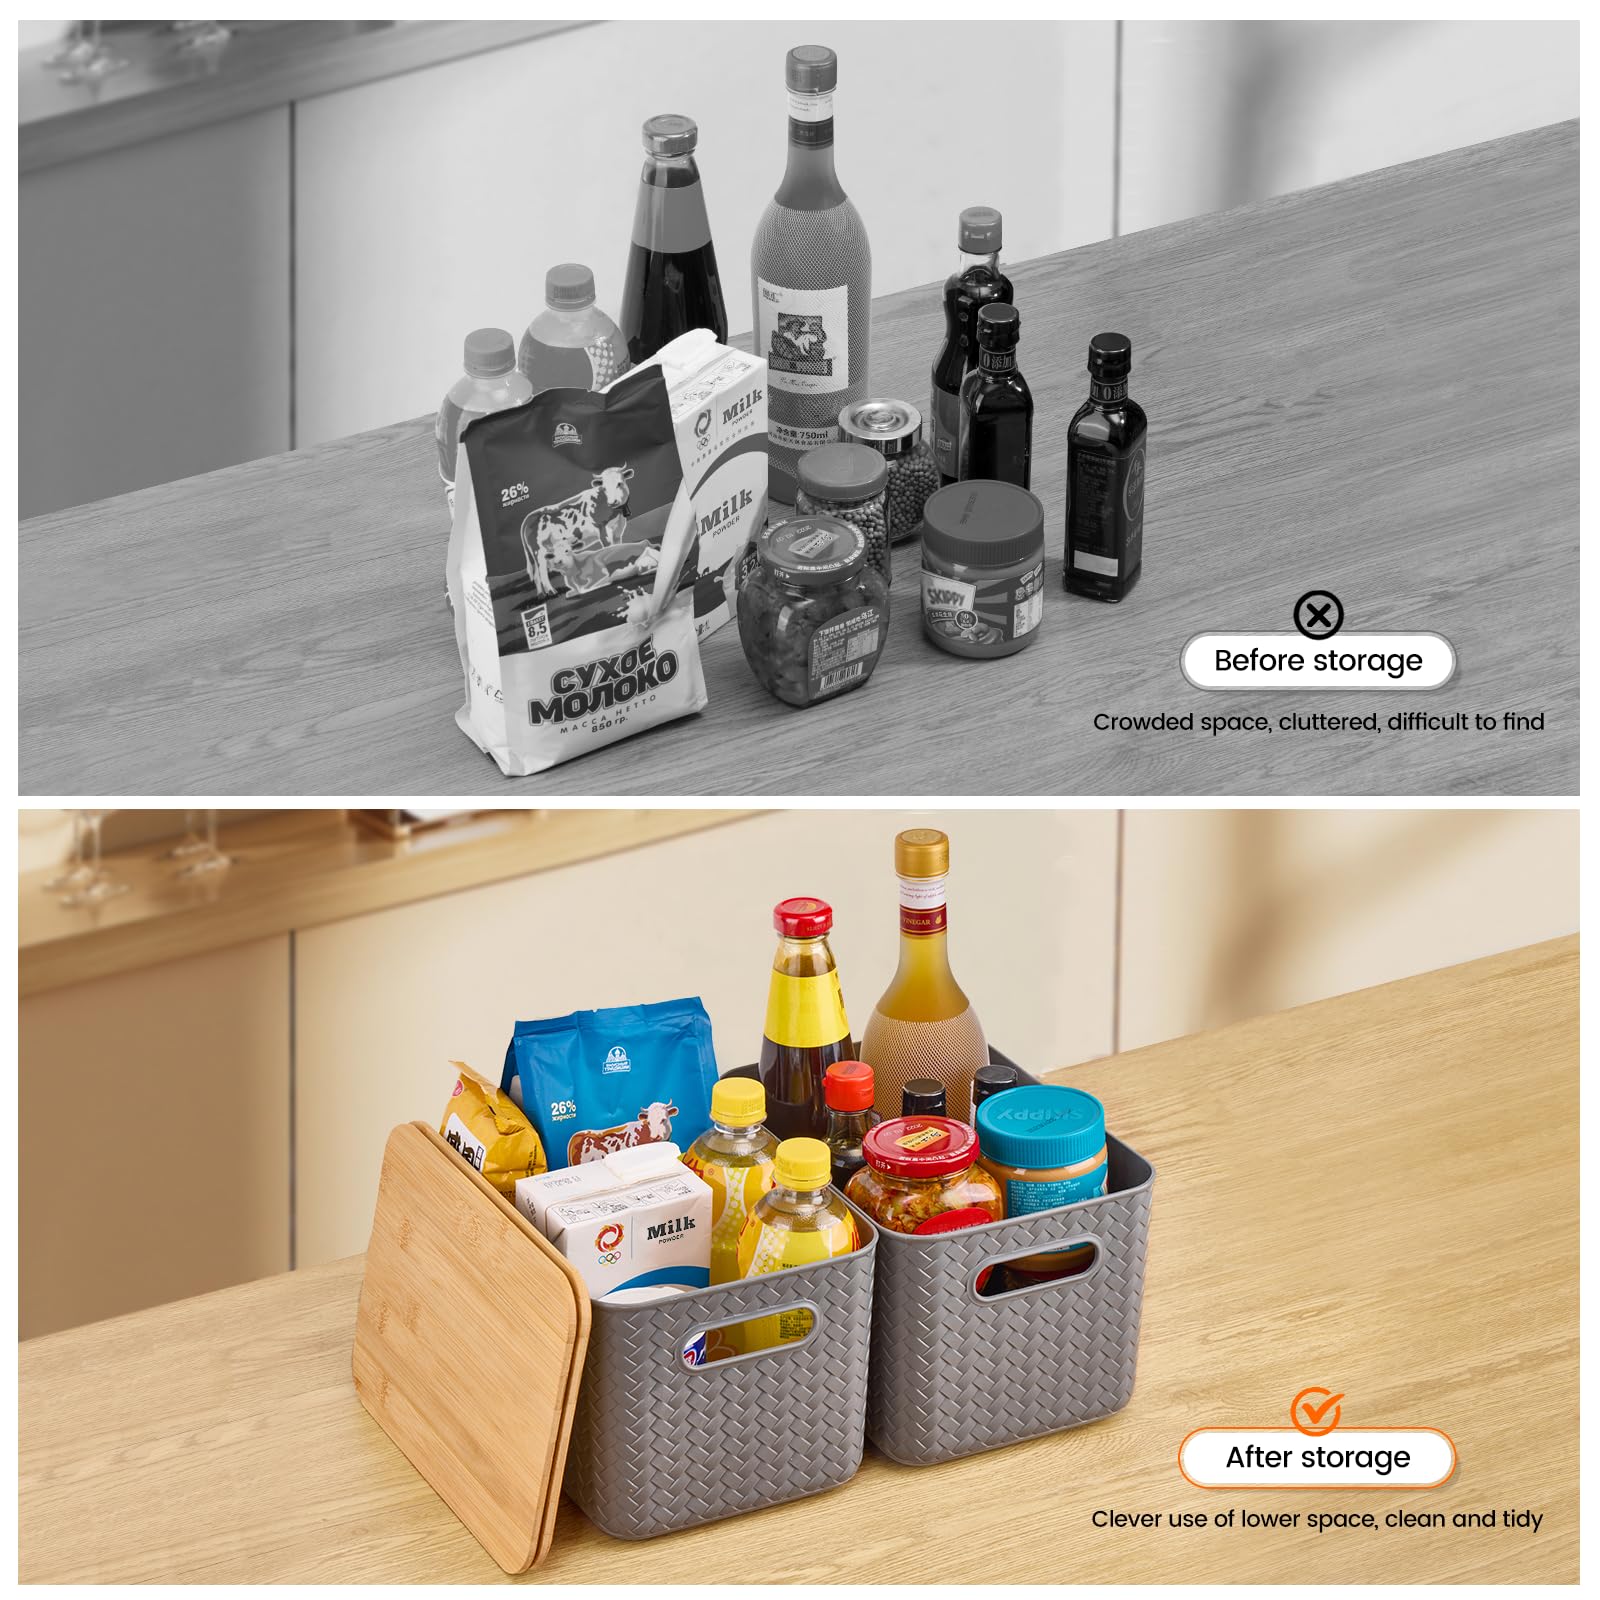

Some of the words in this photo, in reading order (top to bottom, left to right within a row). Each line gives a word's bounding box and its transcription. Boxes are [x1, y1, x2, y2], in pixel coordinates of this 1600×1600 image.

[722, 389, 763, 425] Milk
[731, 409, 753, 427] POWDER
[501, 481, 530, 502] 26%
[700, 488, 753, 537] Milk
[712, 515, 740, 538] POWDER
[927, 588, 966, 607] SKIPPY
[527, 622, 548, 639] 8,5
[551, 635, 657, 695] СУХОЕ
[529, 650, 680, 726] МОЛОКО
[560, 714, 608, 734] МАССА
[615, 695, 658, 716] НЕТТО
[591, 719, 613, 734] 850
[613, 716, 630, 732] гр.
[551, 1100, 577, 1115] 26%
[647, 1215, 696, 1241] Milk
[658, 1233, 685, 1245] POWDER
